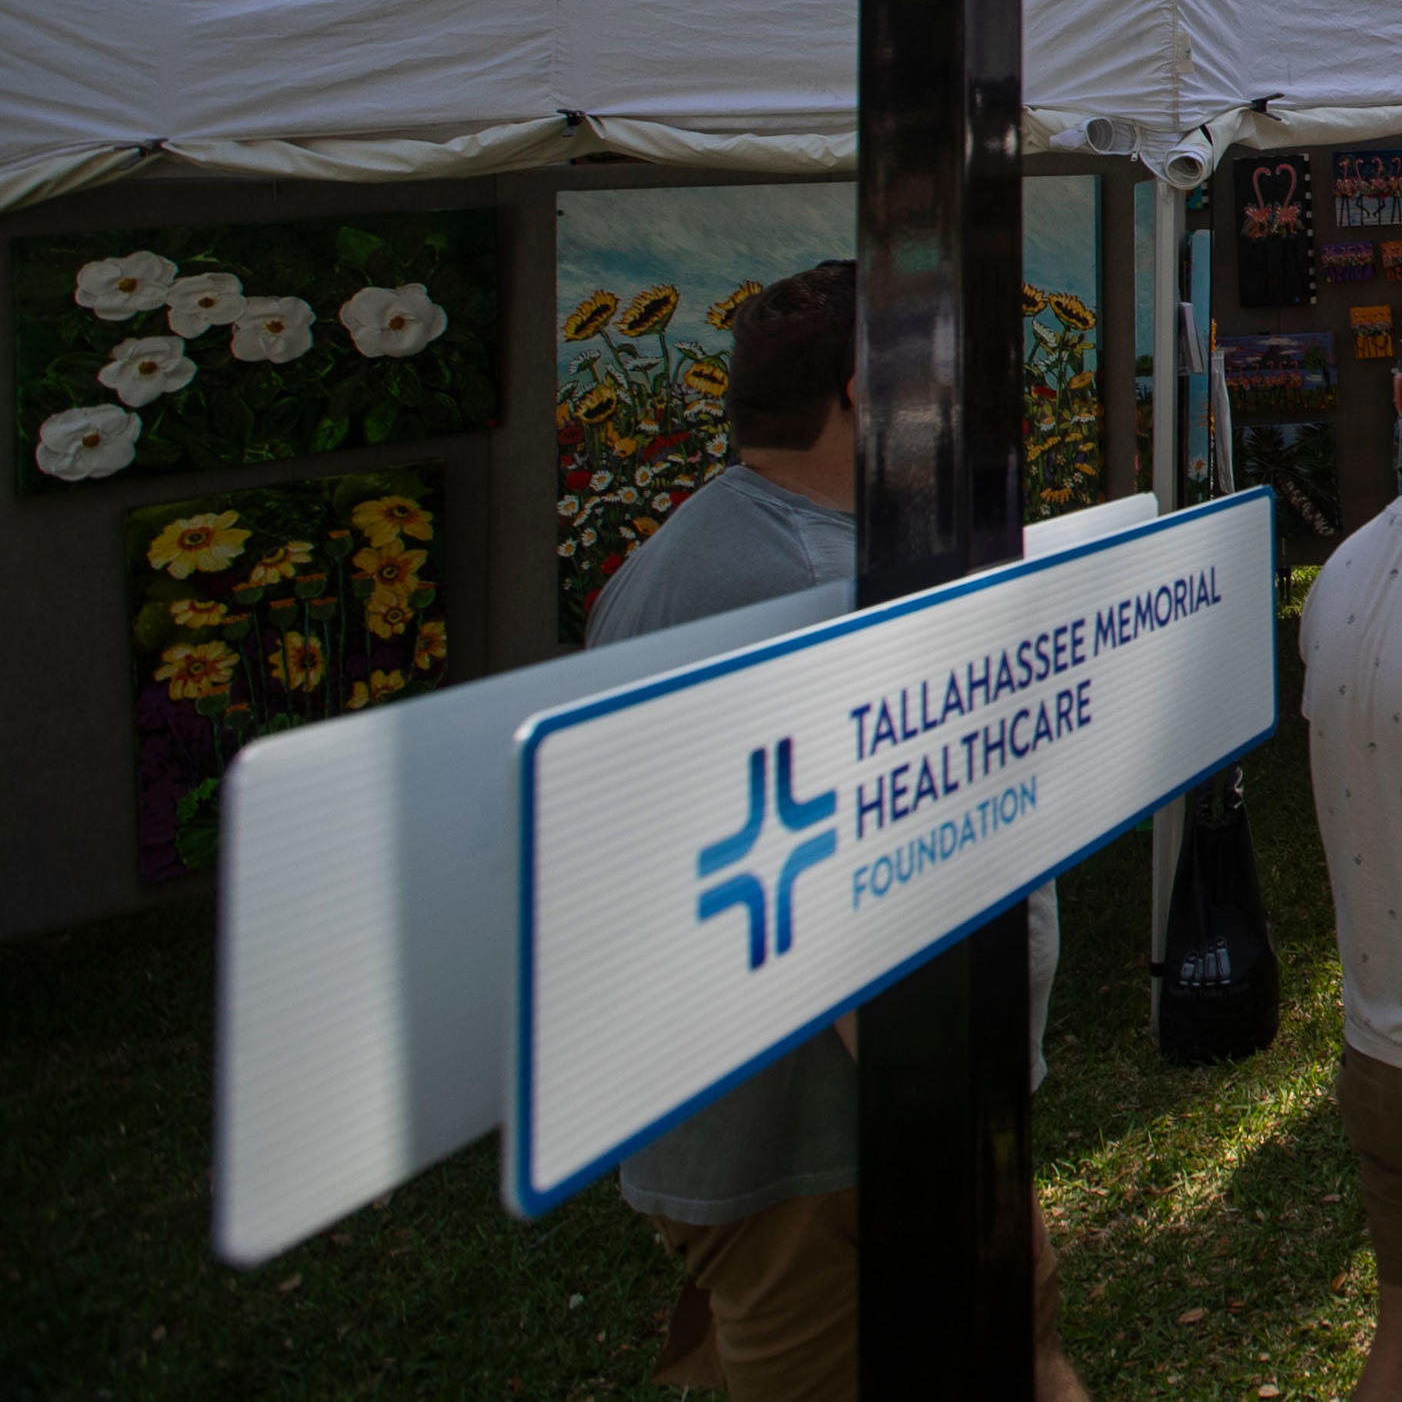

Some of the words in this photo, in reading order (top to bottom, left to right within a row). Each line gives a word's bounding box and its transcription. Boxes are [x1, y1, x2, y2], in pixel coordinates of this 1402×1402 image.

[851, 618, 1086, 761] TALLAHASSEE
[1093, 566, 1222, 658] MEMORIAL
[855, 680, 1092, 840] HEALTHCARE
[853, 776, 1038, 911] FOUNDATION
